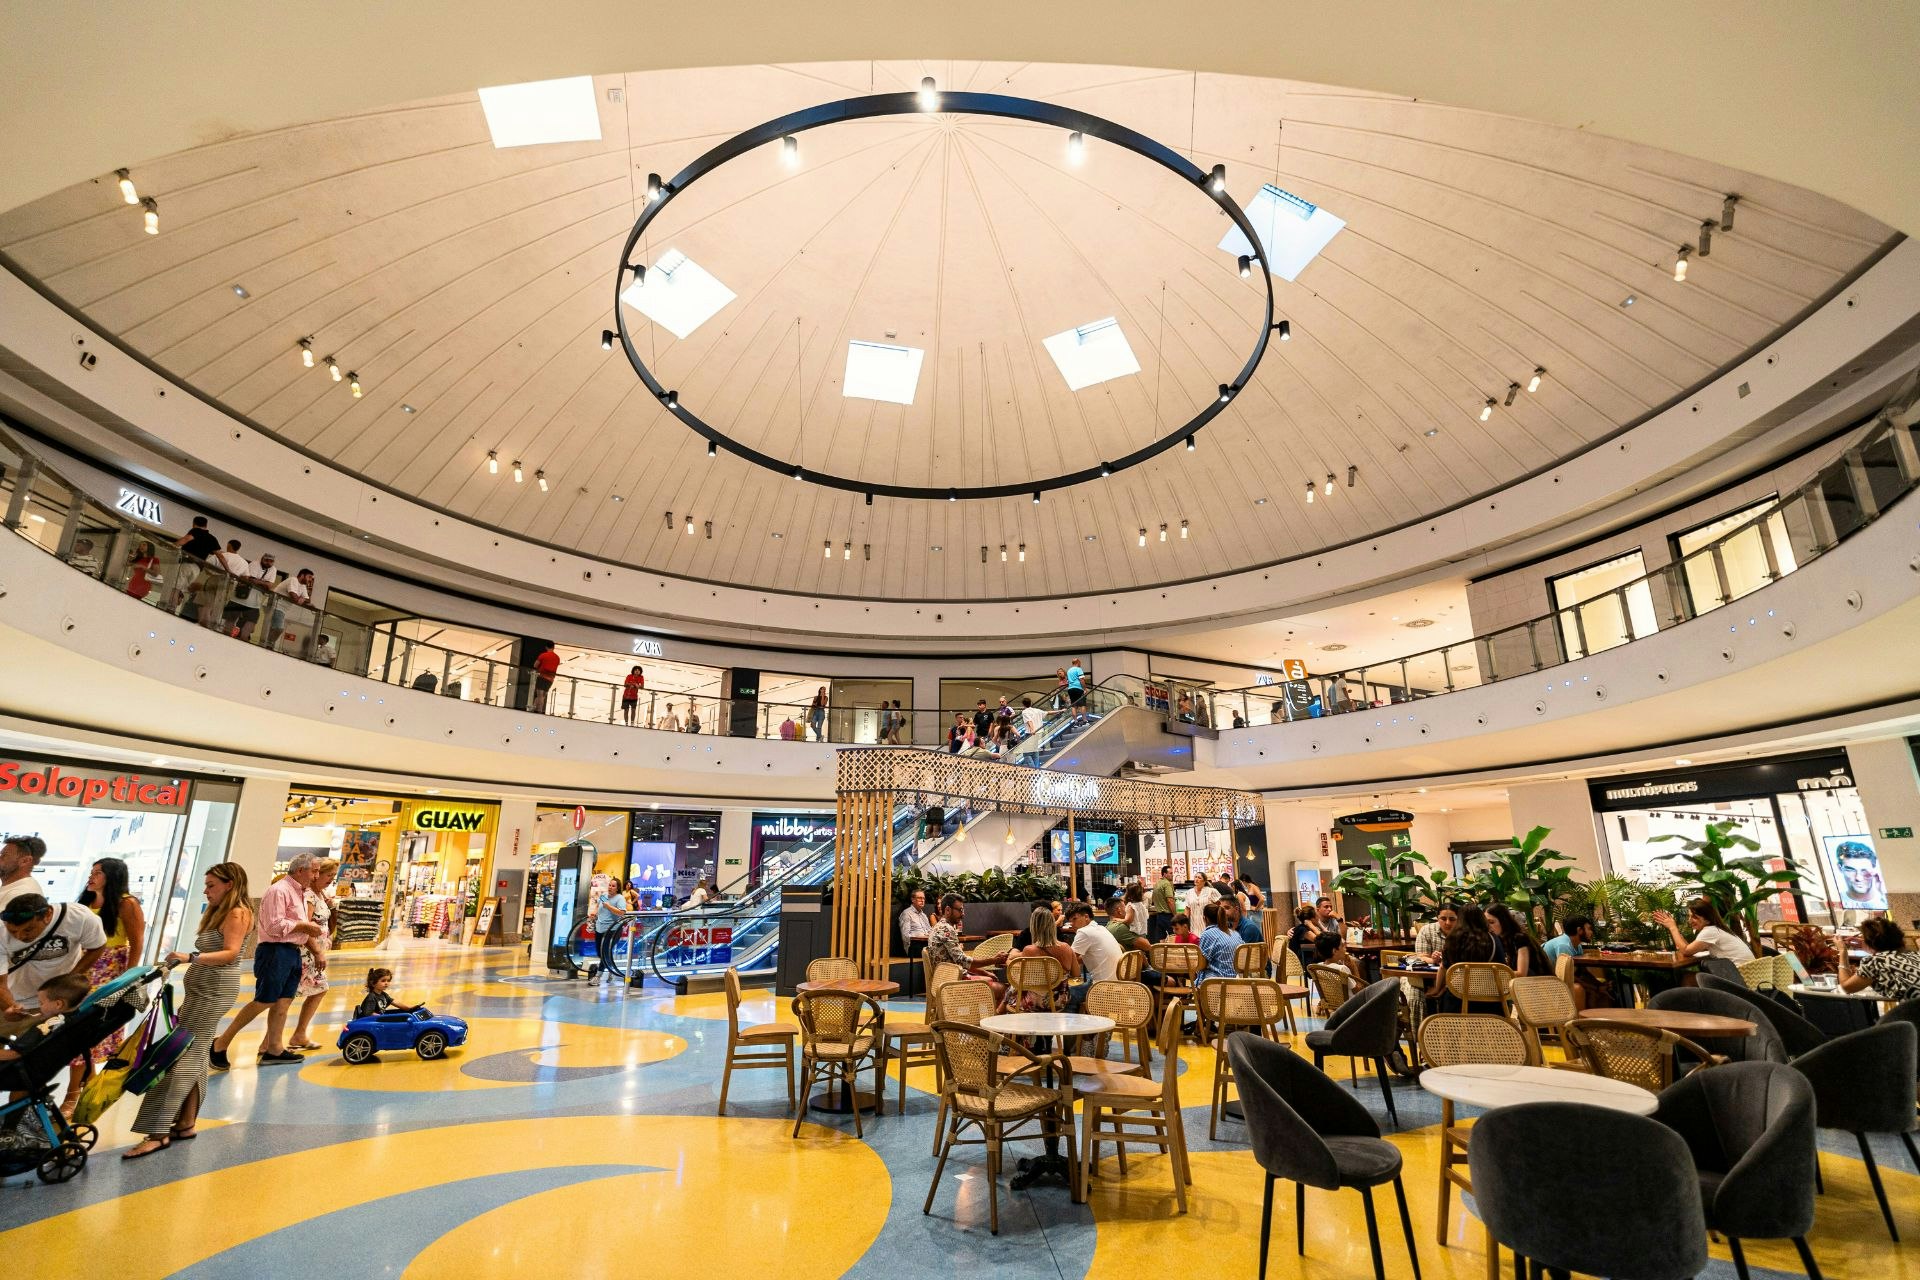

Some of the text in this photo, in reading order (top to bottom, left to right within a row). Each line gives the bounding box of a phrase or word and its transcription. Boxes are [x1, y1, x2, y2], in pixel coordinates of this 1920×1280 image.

[0, 762, 189, 807] Soloptical
[416, 810, 485, 831] GUAW
[761, 817, 814, 842] milbby
[813, 827, 833, 836] arts
